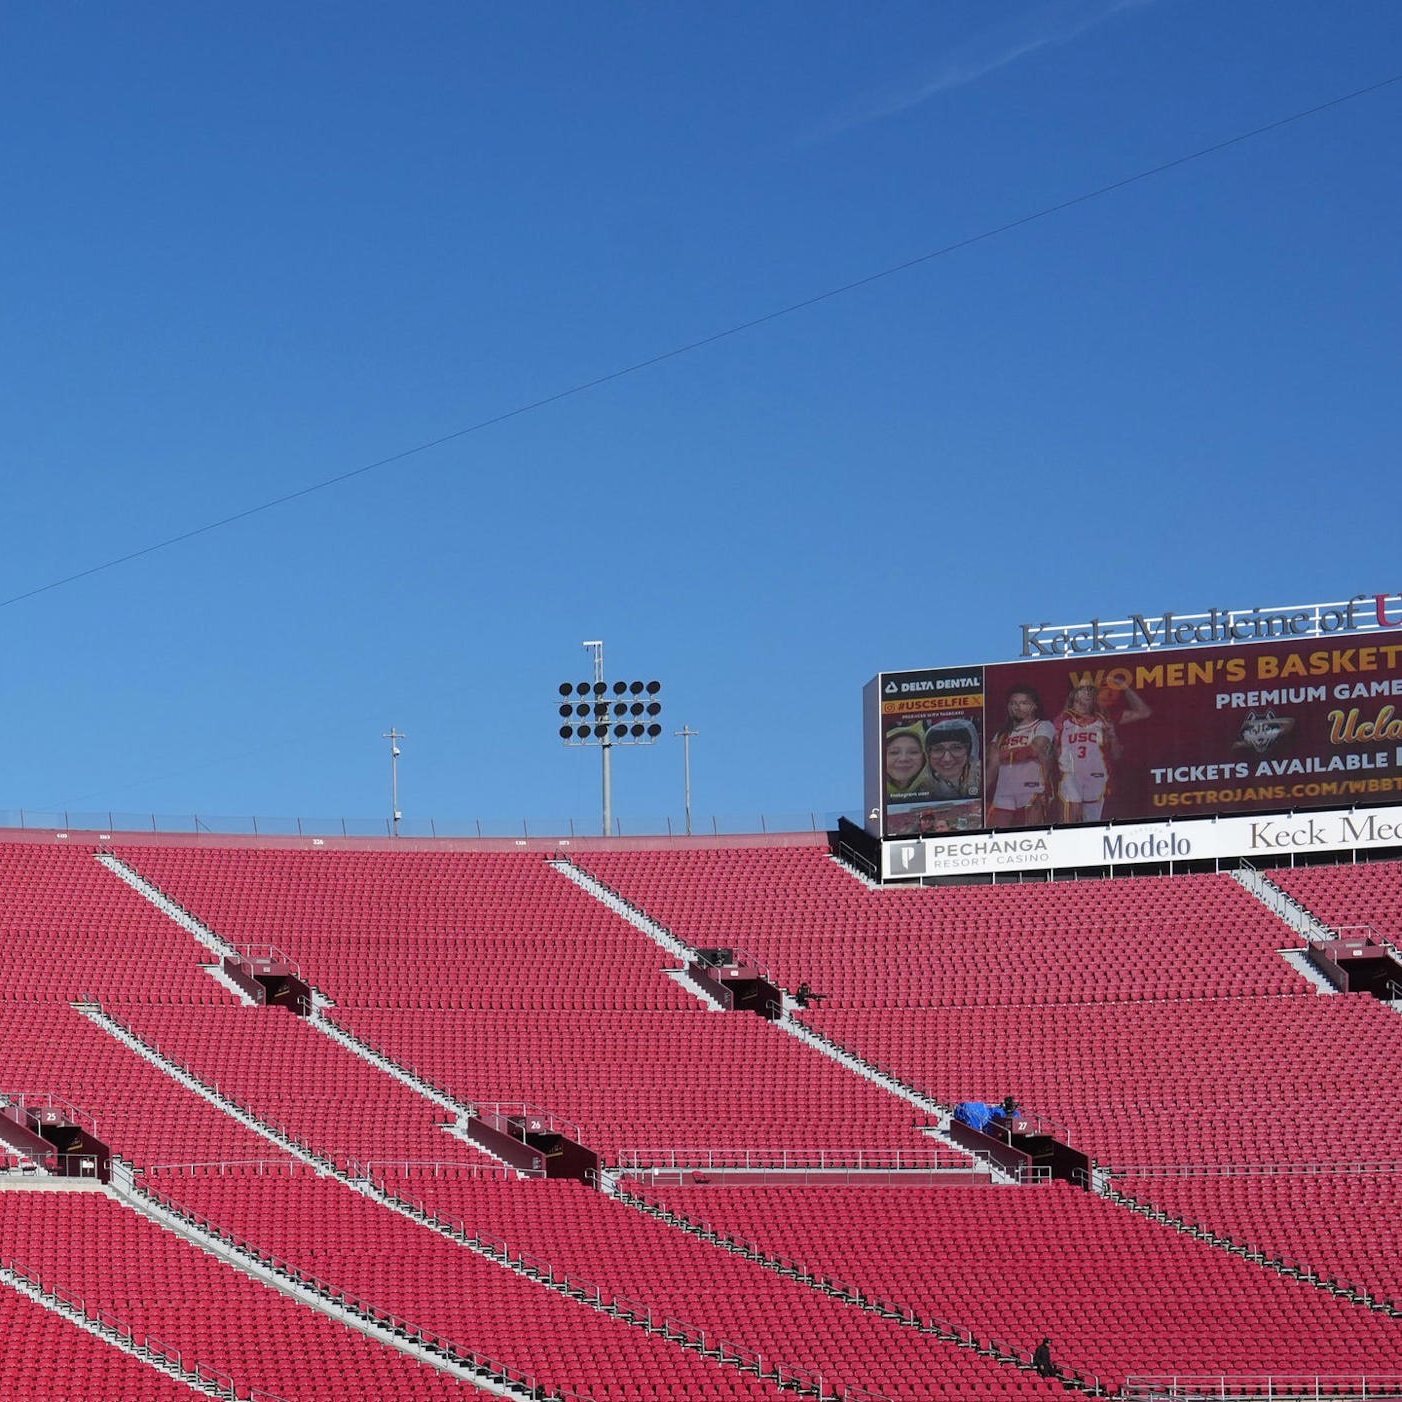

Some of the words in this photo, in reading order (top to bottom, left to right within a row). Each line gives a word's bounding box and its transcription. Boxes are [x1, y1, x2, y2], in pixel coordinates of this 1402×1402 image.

[1019, 618, 1117, 657] Keck
[1128, 607, 1310, 648] Medicine
[1319, 594, 1366, 633] of
[901, 680, 934, 692] DELTA
[936, 677, 980, 690] DENTAL
[897, 697, 969, 711] #USCSELFIE
[1216, 686, 1326, 709] PREMIUM
[1068, 732, 1098, 744] USC
[1077, 746, 1086, 759] 3
[1151, 763, 1249, 784] TICKETS
[1255, 752, 1389, 777] AVAILABLE
[1249, 819, 1329, 849] Keck
[934, 838, 1048, 857] PECHANGA
[1103, 832, 1191, 860] Modelo
[934, 857, 986, 868] RESORT
[997, 853, 1050, 865] CASINO
[46, 1113, 56, 1121] 25
[531, 1121, 541, 1129] 26
[1018, 1122, 1028, 1130] 27
